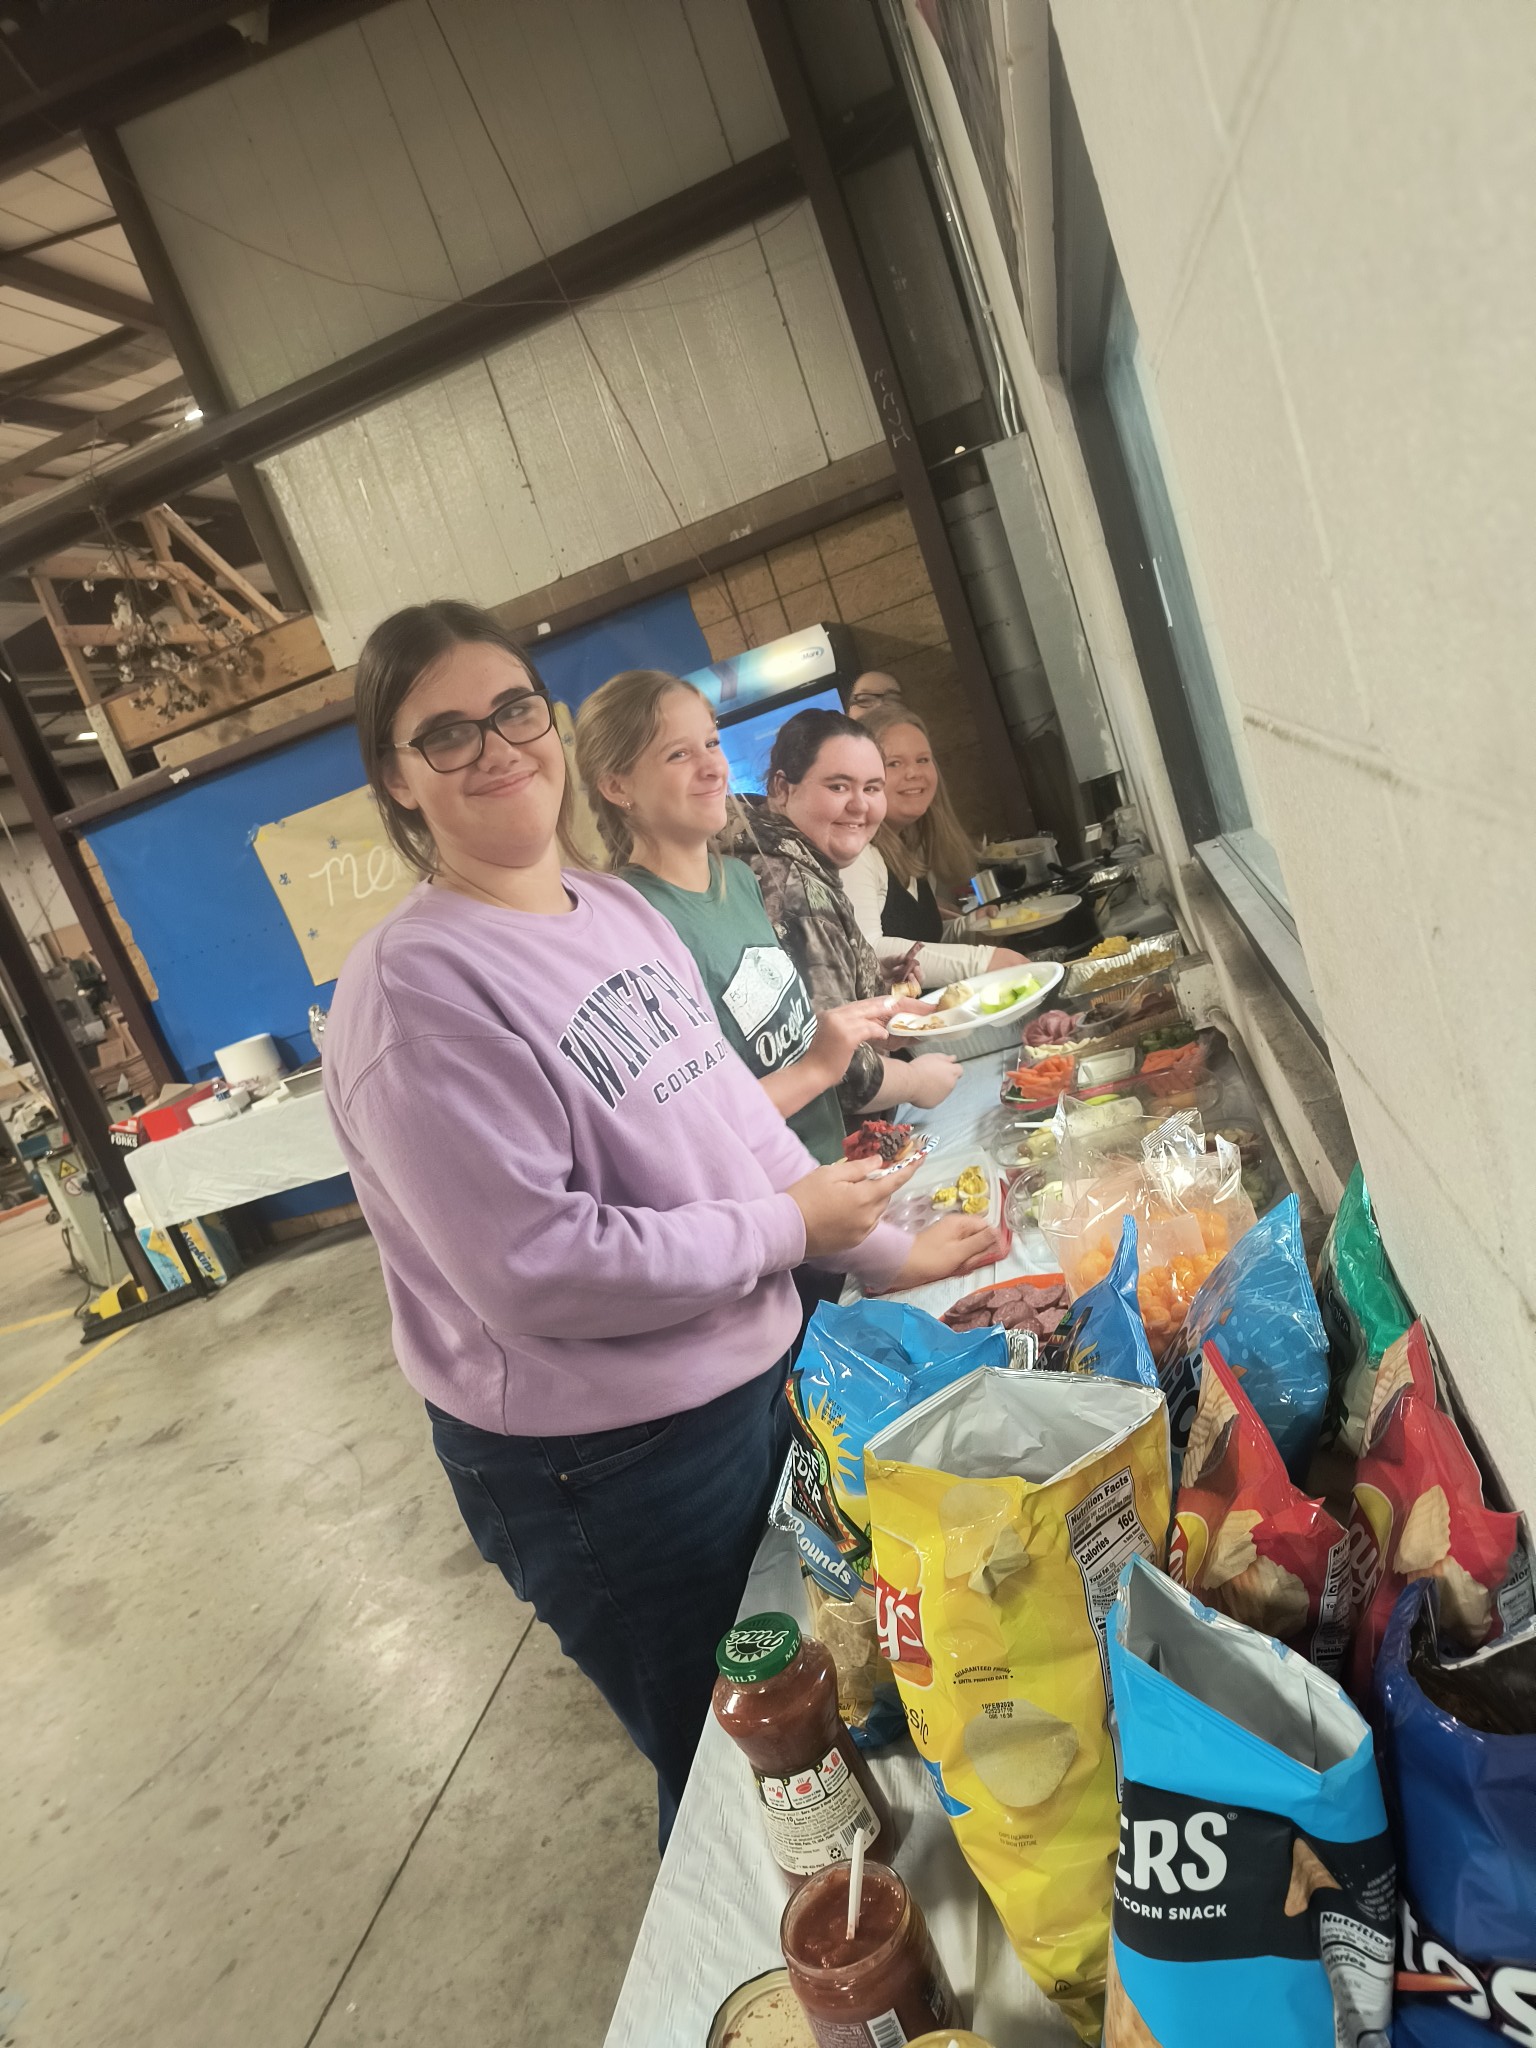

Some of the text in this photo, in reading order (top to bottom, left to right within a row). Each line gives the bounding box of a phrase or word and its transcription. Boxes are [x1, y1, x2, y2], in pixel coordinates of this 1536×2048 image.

[558, 966, 681, 1111] WINTER
[110, 1134, 138, 1148] FORKS
[791, 1444, 826, 1519] RDER
[1070, 1475, 1130, 1526] Nutrition Facts
[1080, 1509, 1135, 1565] Calories 160
[726, 1674, 757, 1683] MILD
[954, 1665, 1012, 1678] GUARANTEED FRESH
[1168, 1903, 1228, 1920] SNACK
